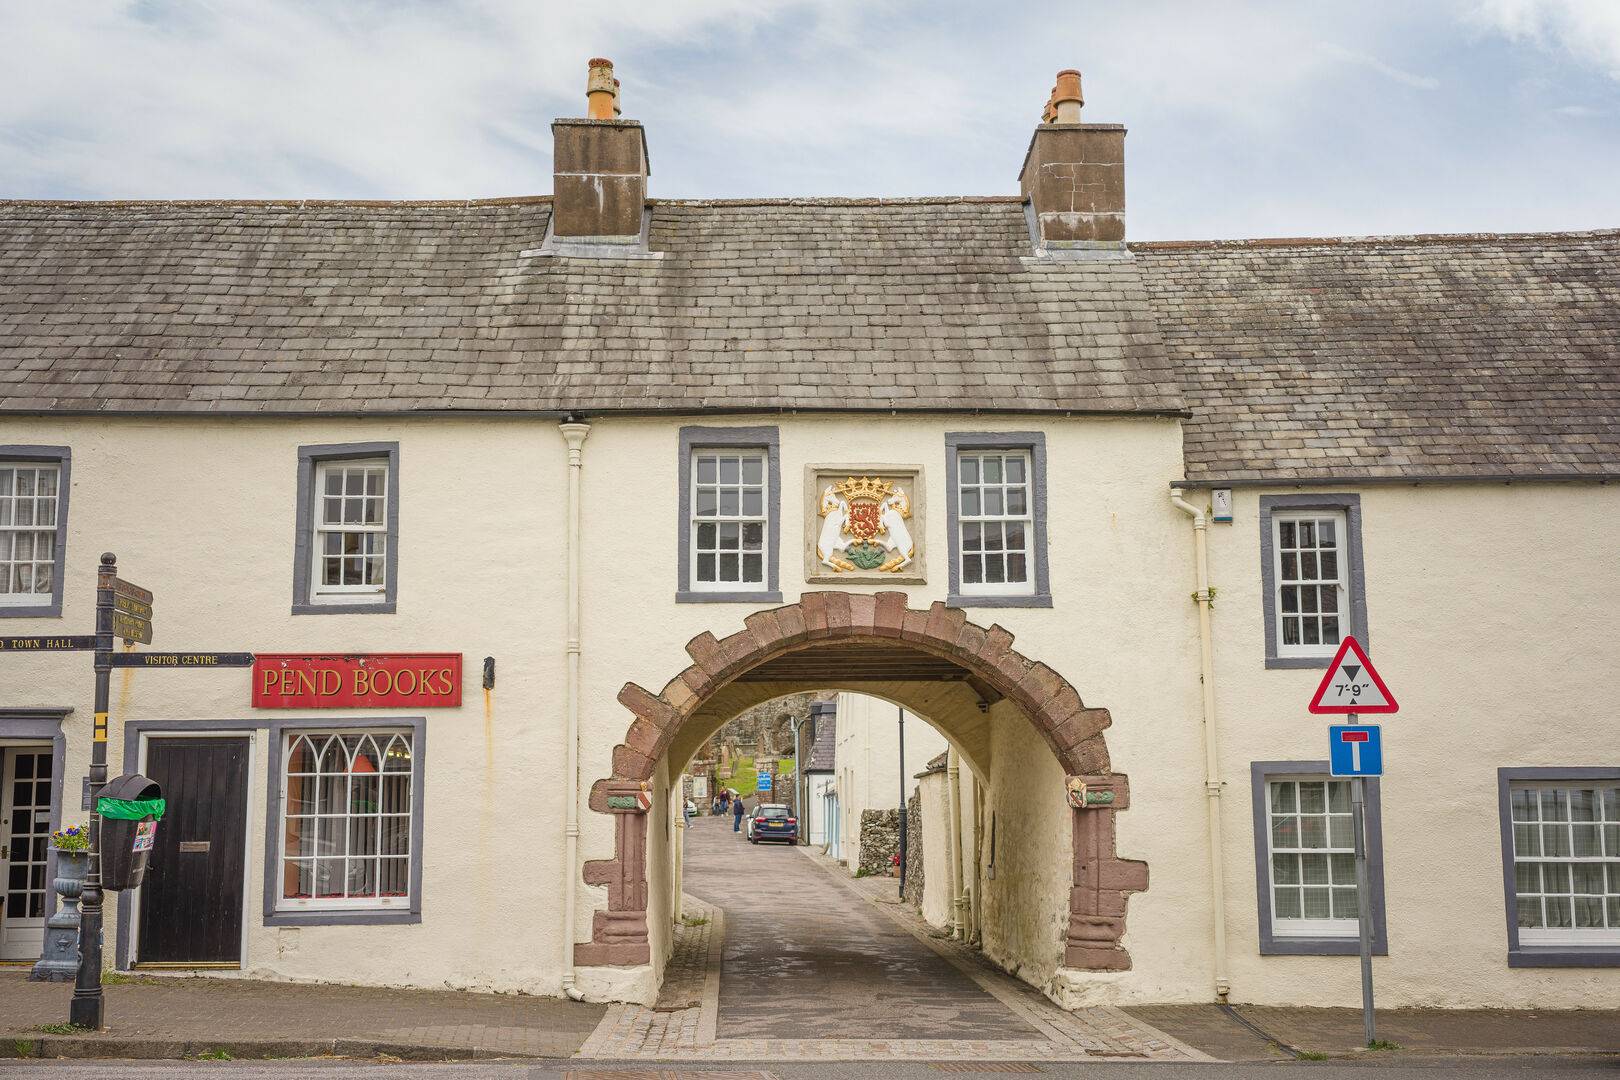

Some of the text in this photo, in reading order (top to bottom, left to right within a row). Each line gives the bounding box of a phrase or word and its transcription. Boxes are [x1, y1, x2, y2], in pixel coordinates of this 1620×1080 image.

[11, 639, 40, 649] TOWN
[46, 638, 74, 648] HALL
[144, 655, 218, 665] VISITOR CENTRE
[261, 669, 454, 696] PEND BOOKS
